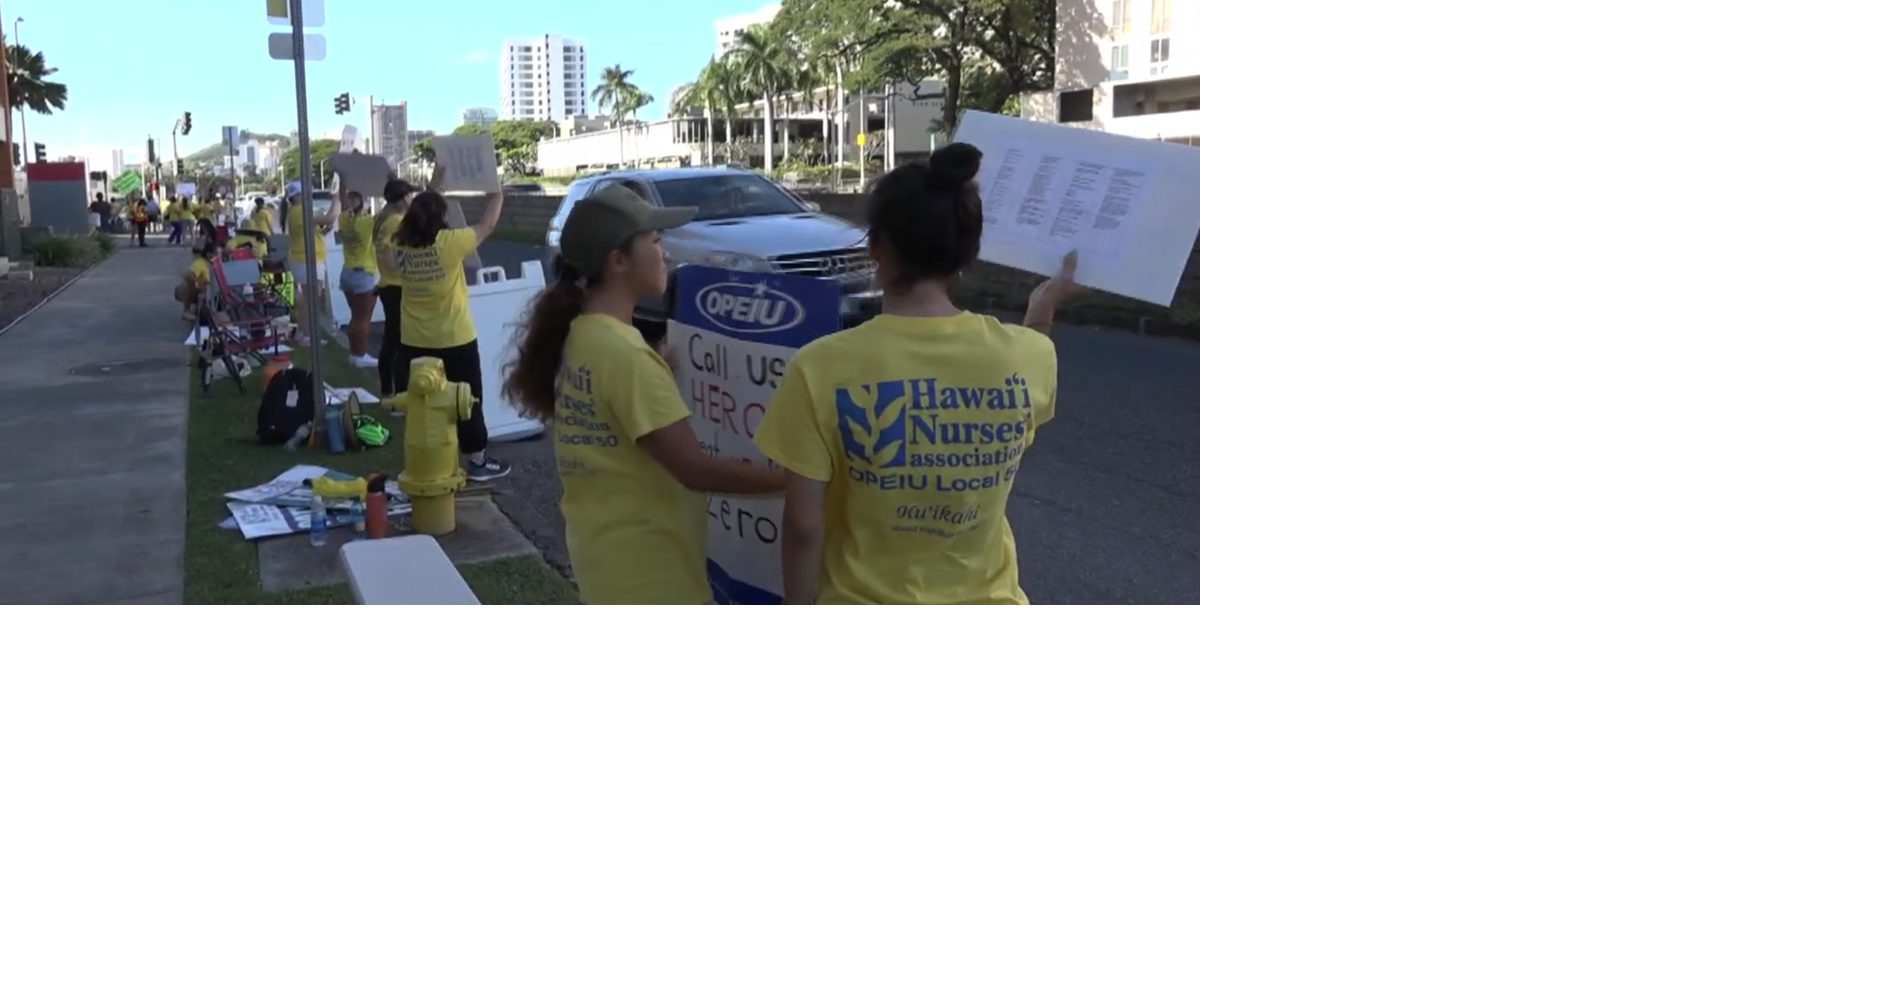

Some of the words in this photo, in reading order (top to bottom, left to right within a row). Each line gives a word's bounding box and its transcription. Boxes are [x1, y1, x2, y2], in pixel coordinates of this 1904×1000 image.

[706, 291, 787, 326] OPEIU
[688, 333, 728, 380] Call
[849, 466, 928, 491] OPEIU
[936, 471, 1000, 491] Local
